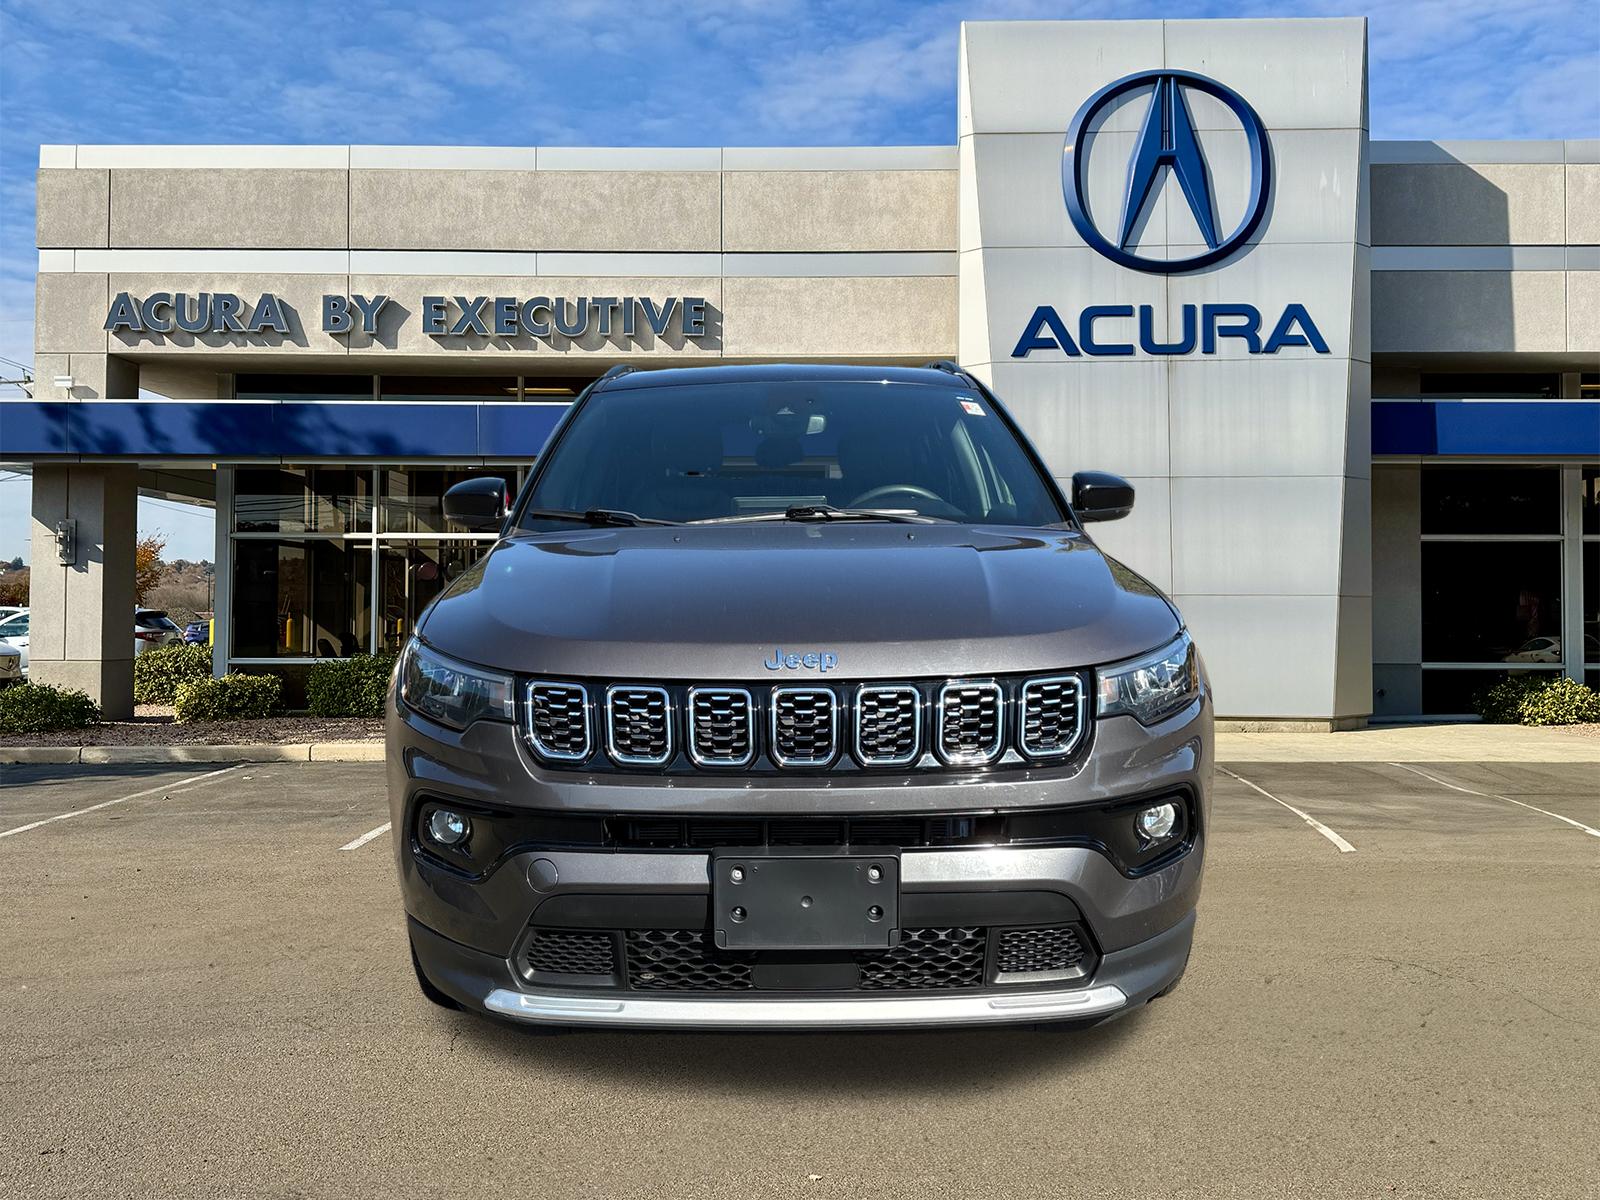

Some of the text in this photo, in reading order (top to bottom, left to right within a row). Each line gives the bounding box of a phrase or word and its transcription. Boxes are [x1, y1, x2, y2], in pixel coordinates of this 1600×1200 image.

[104, 292, 707, 338] ACURA BY EXECUTIVE
[1011, 304, 1331, 357] ACURA
[764, 647, 838, 673] Jeep
